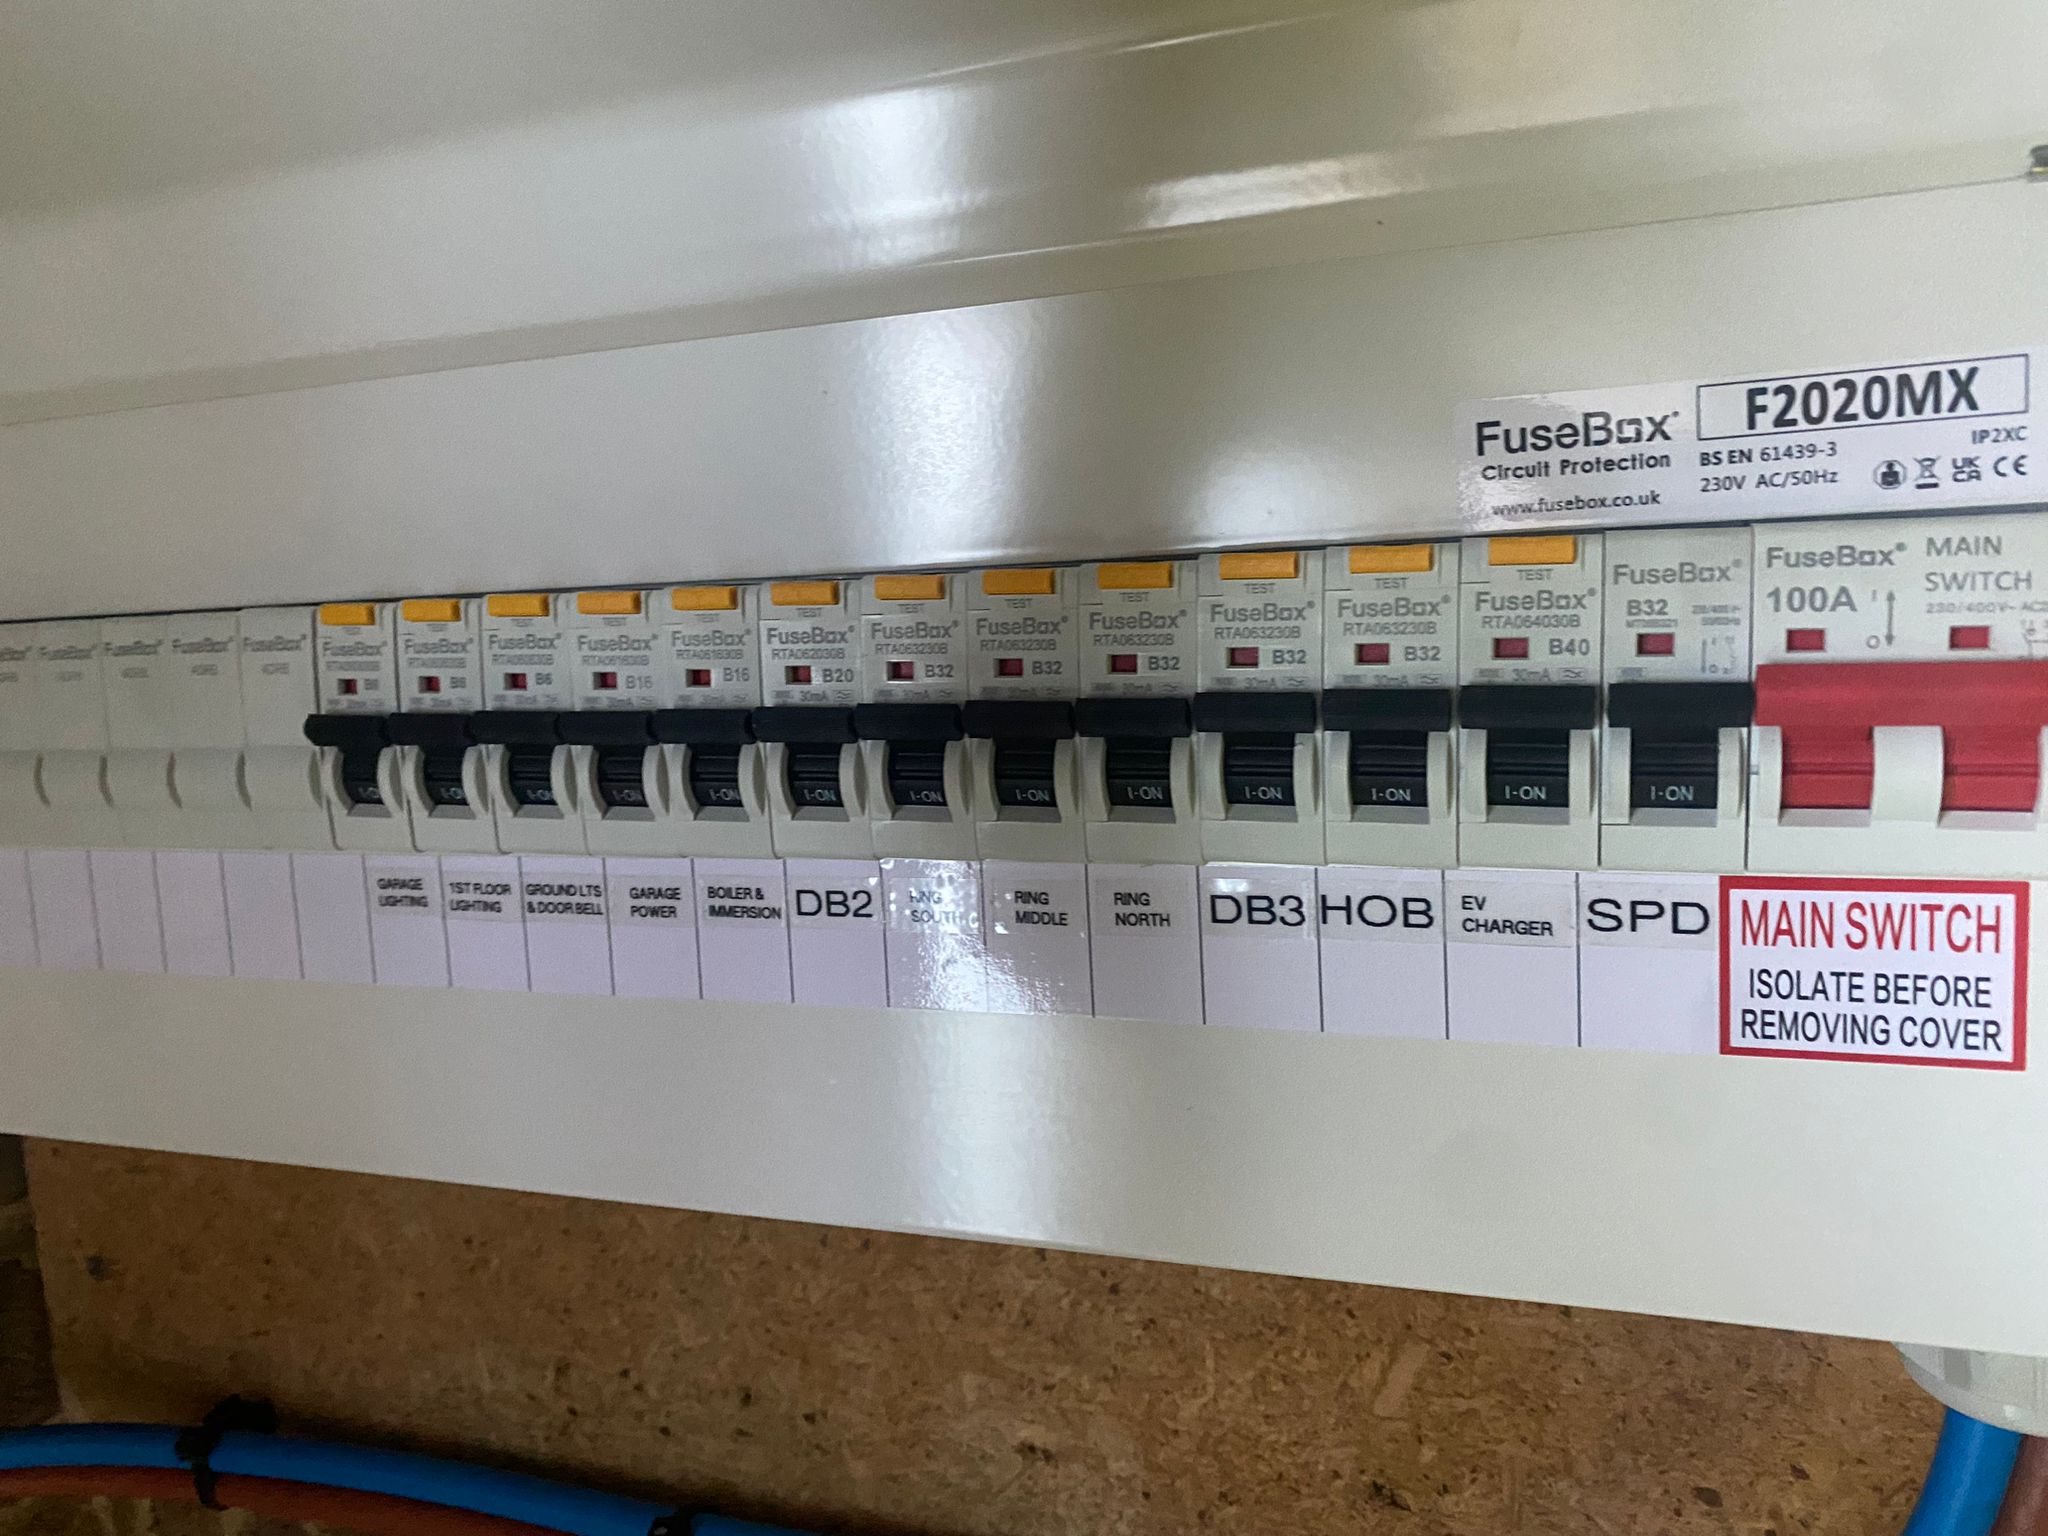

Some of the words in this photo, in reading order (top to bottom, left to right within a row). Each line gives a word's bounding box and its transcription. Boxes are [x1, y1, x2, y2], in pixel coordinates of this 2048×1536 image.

[1747, 366, 1979, 430] F2020MX
[1476, 411, 1674, 456] FuseBox
[1972, 426, 2028, 444] IP2XC
[1700, 451, 1722, 466] BS
[1728, 448, 1752, 464] EN
[1760, 441, 1837, 462] 61439-3
[1481, 460, 1550, 480] Circuit
[1560, 452, 1671, 475] Protection
[1700, 475, 1747, 492] 230V
[1755, 469, 1839, 490] AC/50Hz
[1492, 490, 1661, 516] www.fusebox.co.uk
[1926, 535, 2003, 556] MAIN
[1766, 545, 1896, 568] FuseBox
[1517, 569, 1553, 581] TEST
[1612, 562, 1732, 585] FuseBox
[1925, 571, 2033, 592] SWITCH
[1245, 583, 1276, 594] TEST
[1375, 577, 1408, 589] TEST
[1337, 597, 1442, 618] FuseBox
[1475, 590, 1587, 611] FuseBox
[1627, 599, 1669, 616] B32
[1766, 586, 1858, 613] 100A
[1089, 611, 1180, 631] FuseBox
[1210, 603, 1307, 623] FuseBox
[871, 621, 953, 640] FuseBox
[976, 617, 1061, 636] FuseBox
[671, 629, 746, 647] FuseBox
[767, 627, 849, 645] FuseBox
[1404, 646, 1441, 661] B32
[1549, 638, 1590, 656] B40
[1148, 656, 1180, 671] B32
[1272, 649, 1307, 665] B32
[723, 667, 750, 681] B16
[822, 668, 854, 683] B20
[924, 664, 954, 678] B32
[1031, 660, 1063, 675] B32
[1127, 786, 1164, 800] I-ON
[1245, 786, 1283, 800] I-ON
[1371, 787, 1411, 801] I-ON
[1505, 785, 1547, 801] I-ON
[1650, 785, 1695, 801] I-ON
[449, 882, 471, 894] 1ST
[473, 882, 511, 896] FLOOR
[526, 883, 577, 897] GROUND
[580, 885, 602, 898] LTS
[629, 887, 681, 901] GARAGE
[708, 886, 752, 900] BOILER
[755, 887, 764, 901] &
[450, 900, 502, 913] LIGHTING
[796, 889, 873, 918] DB2
[1014, 891, 1049, 905] RING
[1114, 892, 1150, 906] RING
[1461, 895, 1487, 910] EV
[527, 901, 536, 913] &
[537, 901, 574, 914] DOOR
[575, 902, 604, 916] BELL
[631, 905, 678, 919] POWER
[709, 905, 782, 920] IMMERSION
[1210, 894, 1306, 927] DB3
[1321, 894, 1434, 929] HOB
[1587, 898, 1710, 935] SPD
[1015, 911, 1068, 926] MIDDLE
[1115, 913, 1171, 927] NORTH
[1462, 917, 1553, 936] CHARGER
[1741, 899, 1834, 949] MAIN
[1845, 901, 2001, 953] SWITCH
[1749, 968, 1864, 1003] ISOLATE
[1874, 972, 1992, 1009] BEFORE
[1741, 1008, 1890, 1046] REMOVING
[1899, 1016, 2002, 1053] COVER
